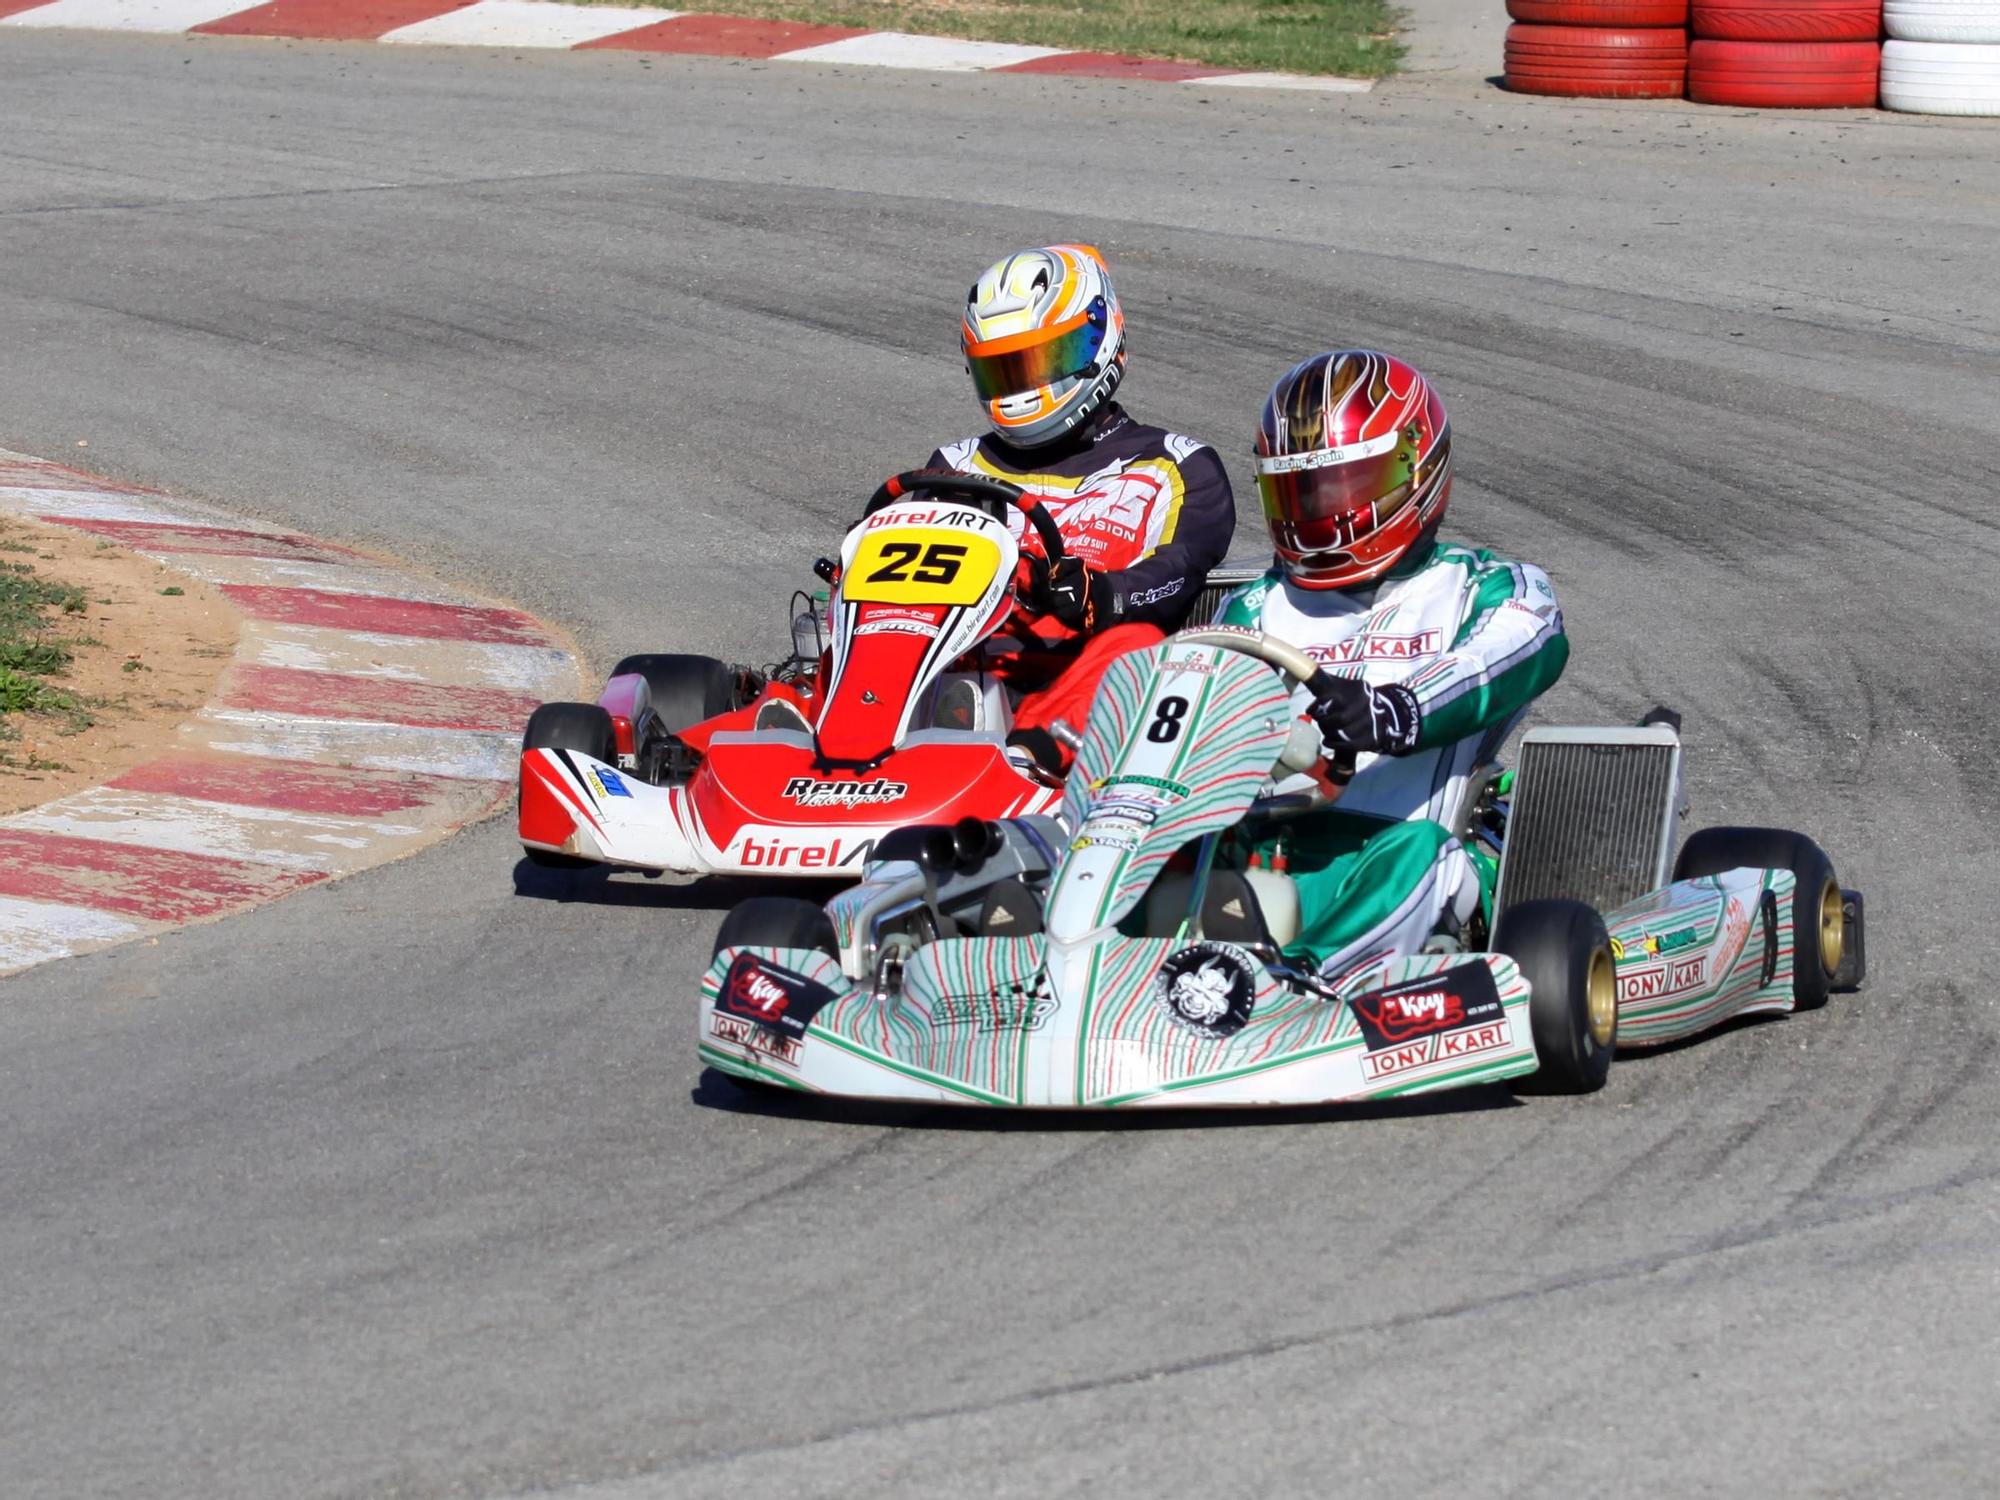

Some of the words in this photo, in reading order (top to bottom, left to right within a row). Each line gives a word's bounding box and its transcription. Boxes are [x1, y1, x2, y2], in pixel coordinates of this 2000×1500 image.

[867, 510, 996, 531] birelART
[865, 542, 969, 585] 25
[1370, 631, 1440, 656] KART
[1146, 695, 1190, 743] 8
[783, 778, 906, 797] Renda
[1616, 968, 1665, 1000] TONY
[1674, 957, 1706, 989] KART
[1398, 993, 1445, 1019] Key
[711, 1012, 750, 1041] TONY
[1364, 1041, 1428, 1075] TONY
[1445, 1021, 1506, 1055] KART
